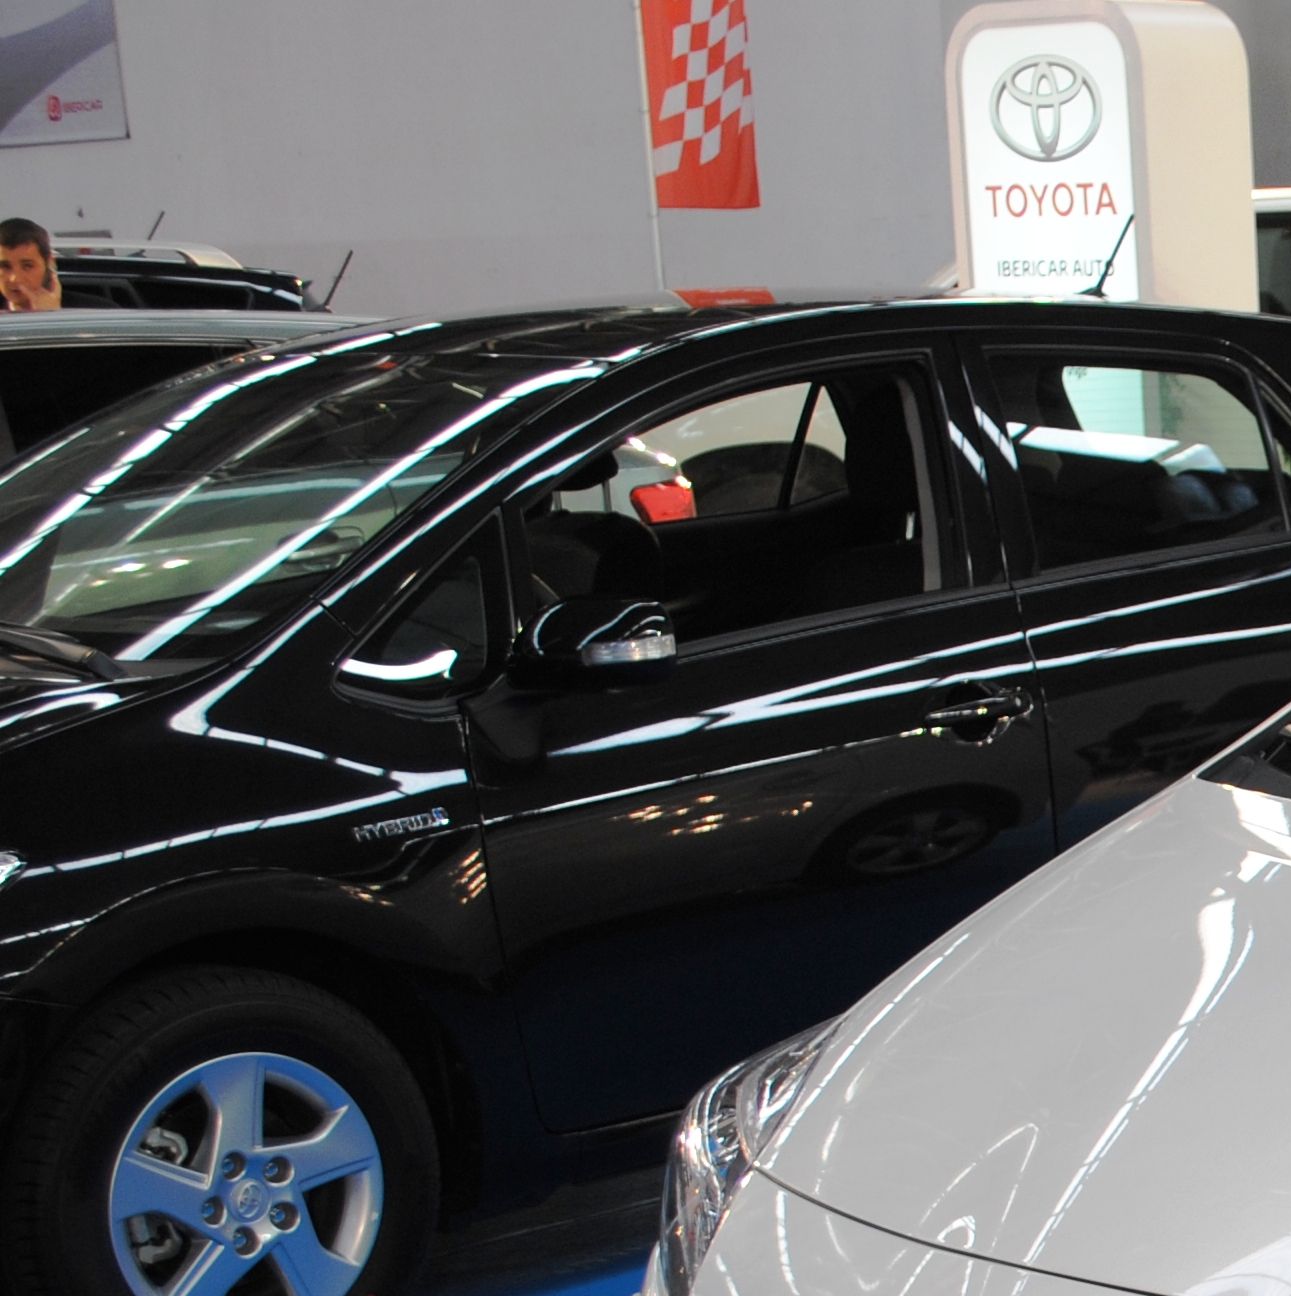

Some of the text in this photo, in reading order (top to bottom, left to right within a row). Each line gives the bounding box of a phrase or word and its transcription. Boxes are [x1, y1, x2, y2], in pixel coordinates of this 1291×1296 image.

[985, 183, 1118, 217] TOYOTA
[997, 260, 1115, 278] IBERICAR AUTO
[353, 812, 433, 842] HYBRID
